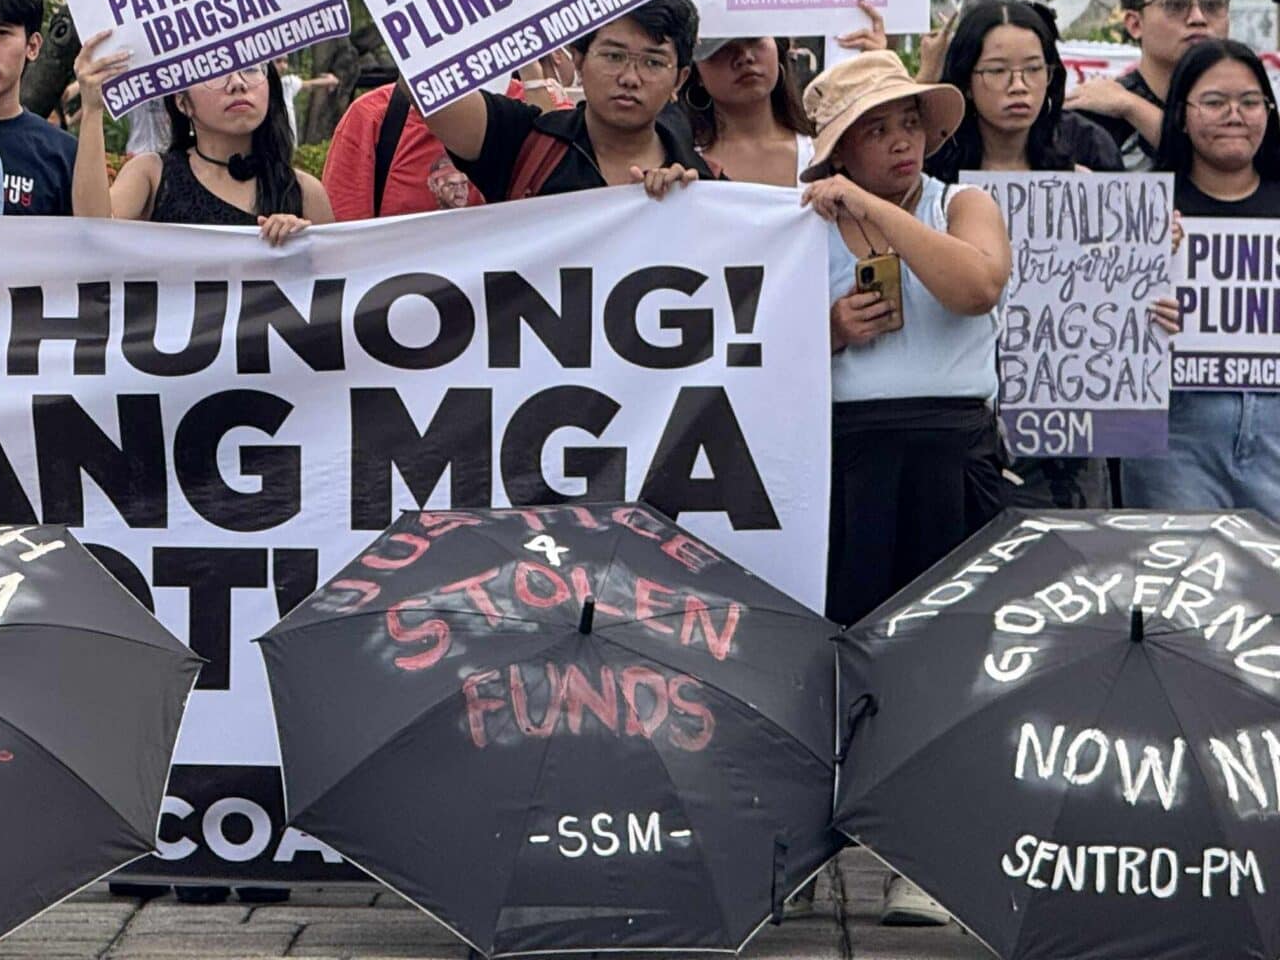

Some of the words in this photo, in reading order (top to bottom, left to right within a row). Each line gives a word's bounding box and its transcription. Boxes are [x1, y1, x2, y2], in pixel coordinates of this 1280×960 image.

[105, 72, 156, 111] SAFE
[156, 45, 234, 89] SPACES
[235, 4, 346, 64] MOVEMENT
[416, 64, 469, 107] SAFE
[465, 30, 543, 81] SPACES
[1187, 234, 1280, 281] PUNI
[1000, 351, 1162, 404] BAGSAK
[1174, 357, 1220, 384] SAFE
[350, 384, 782, 532] MGA
[1016, 411, 1093, 455] SSM
[1144, 540, 1226, 591] SA
[386, 561, 742, 671] STOLEN
[462, 662, 716, 751] FUNDS
[1014, 723, 1186, 811] NOW
[1002, 834, 1266, 898] SENTRO-PM
